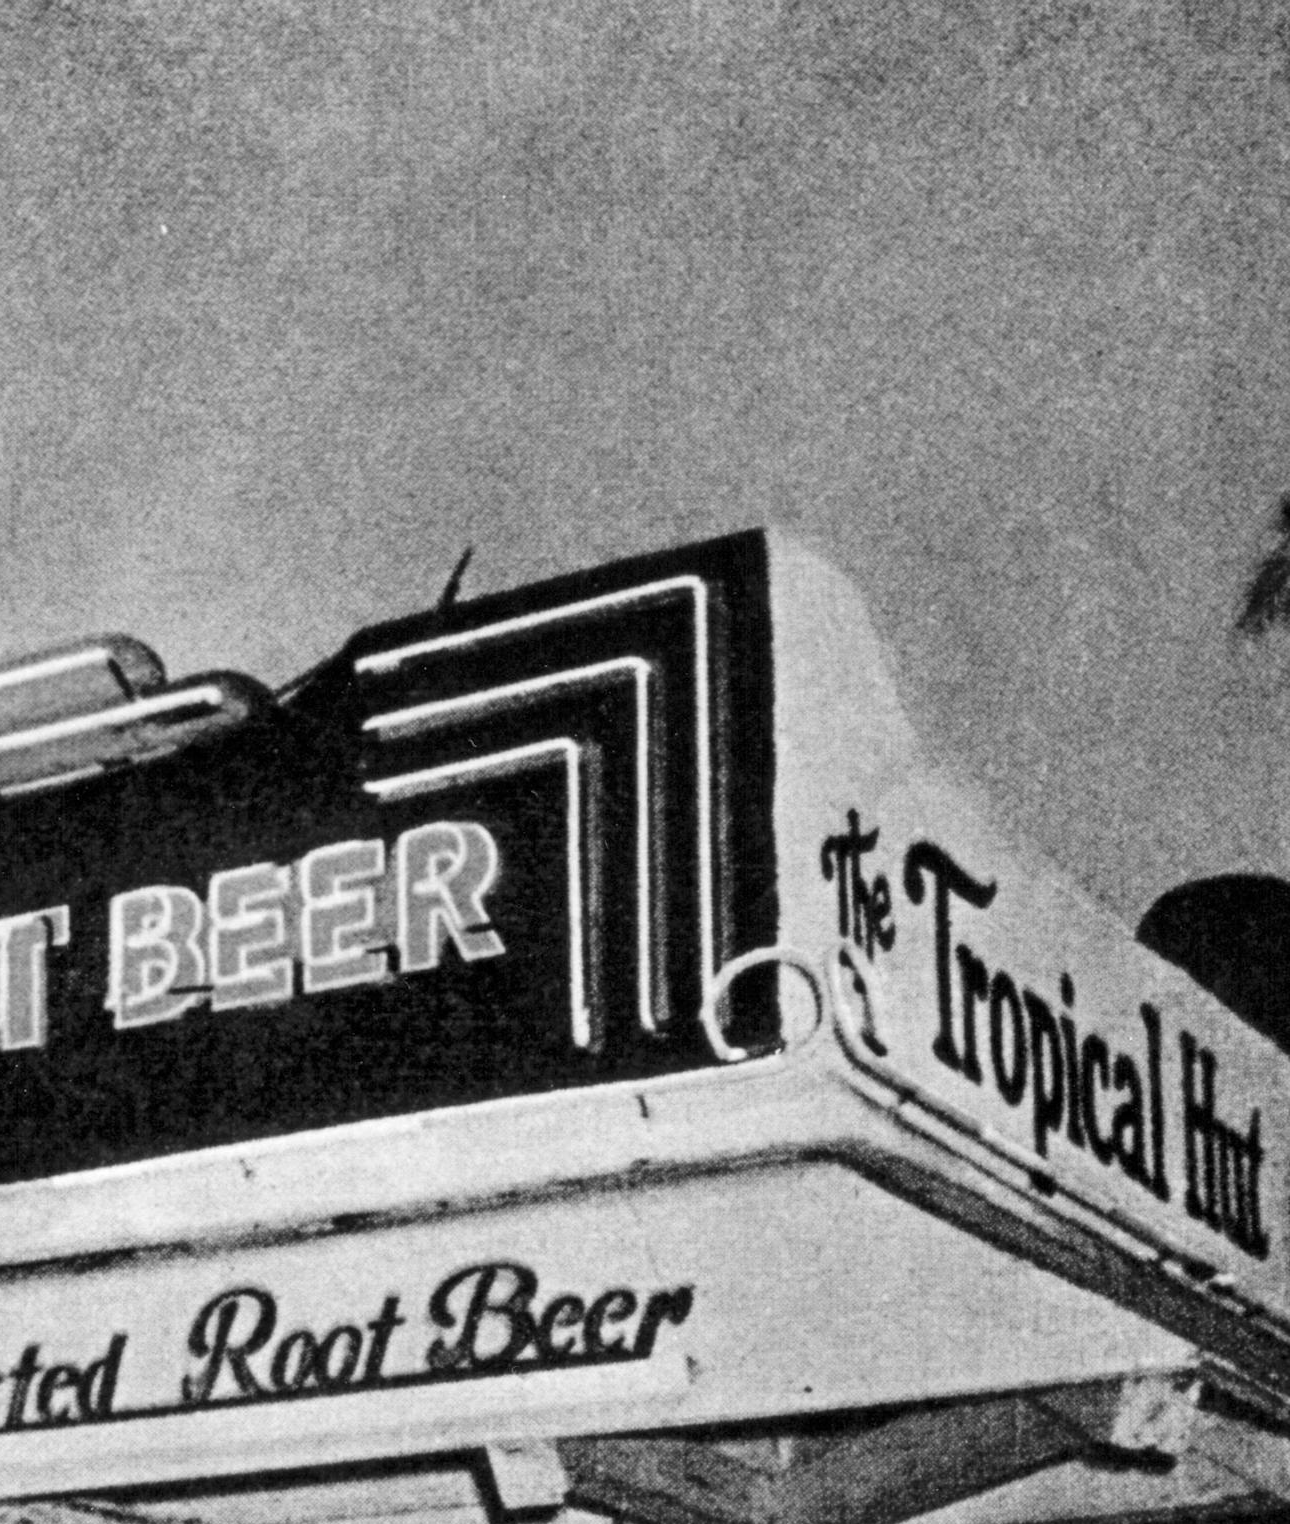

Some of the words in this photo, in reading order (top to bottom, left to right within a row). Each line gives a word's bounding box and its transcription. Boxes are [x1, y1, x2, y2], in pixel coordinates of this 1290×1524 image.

[103, 821, 507, 1030] BEER
[903, 840, 1171, 1203] Tropical
[1180, 1030, 1271, 1262] Hut
[183, 1285, 404, 1402] Root
[427, 1260, 696, 1372] Beer
